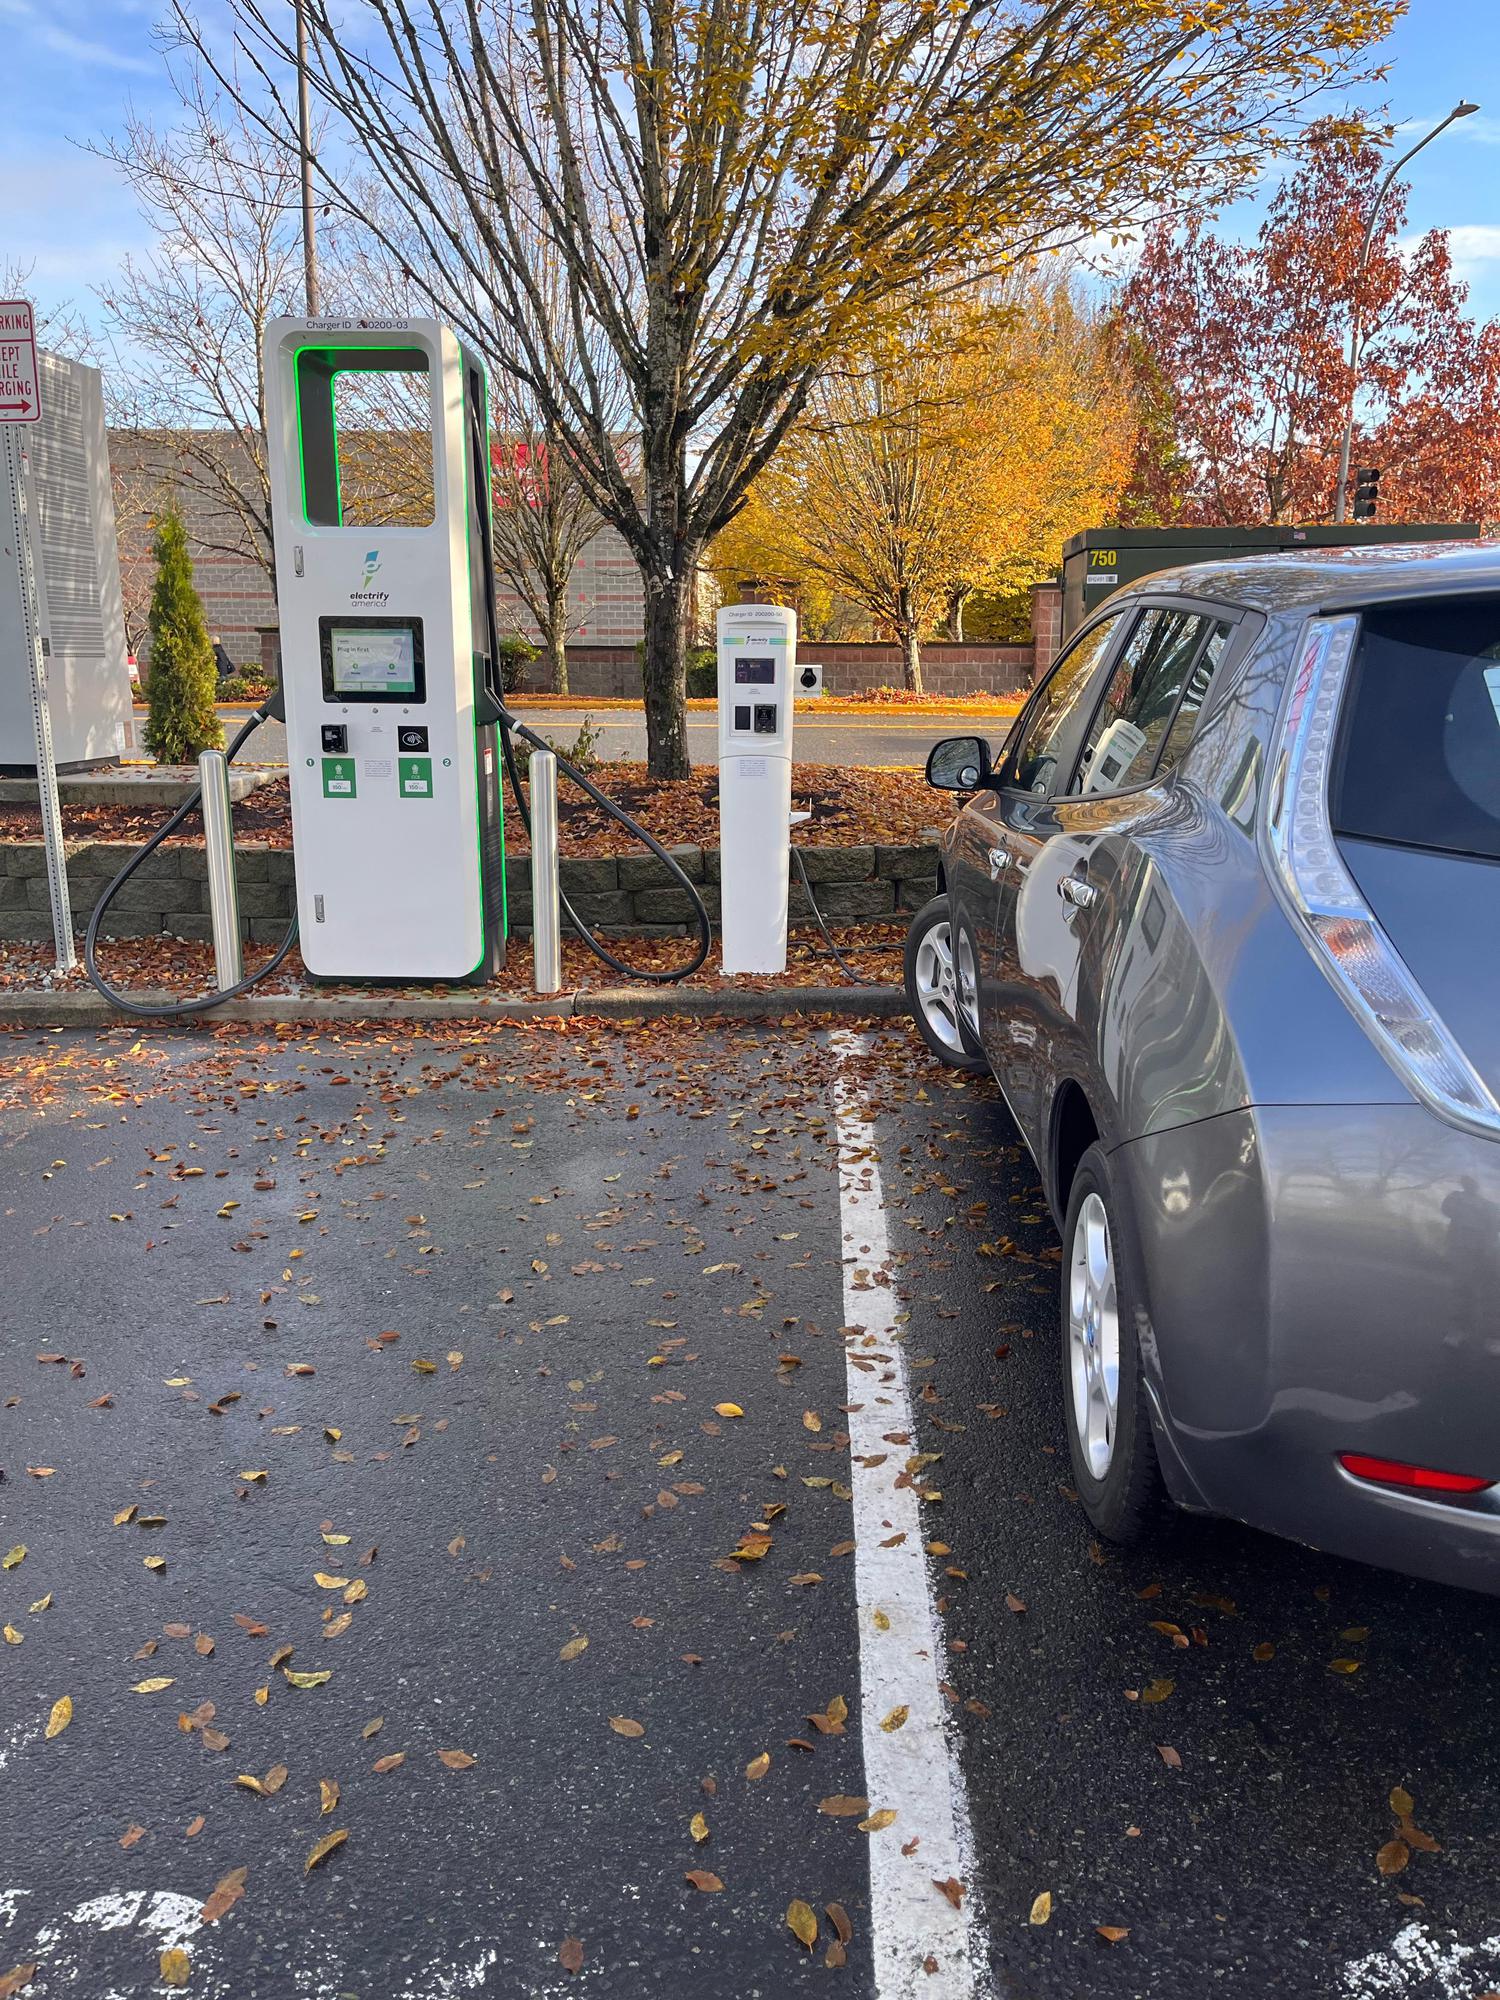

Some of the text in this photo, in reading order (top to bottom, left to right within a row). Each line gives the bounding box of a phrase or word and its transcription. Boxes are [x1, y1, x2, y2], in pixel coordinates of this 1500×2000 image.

[0, 314, 29, 330] RKING
[306, 320, 409, 330] Charger ID 20200-03
[1, 346, 20, 361] EPT
[0, 363, 19, 379] ILE
[0, 380, 31, 396] RGING
[1090, 550, 1117, 566] 750
[350, 592, 390, 601] electrify
[351, 599, 387, 608] america
